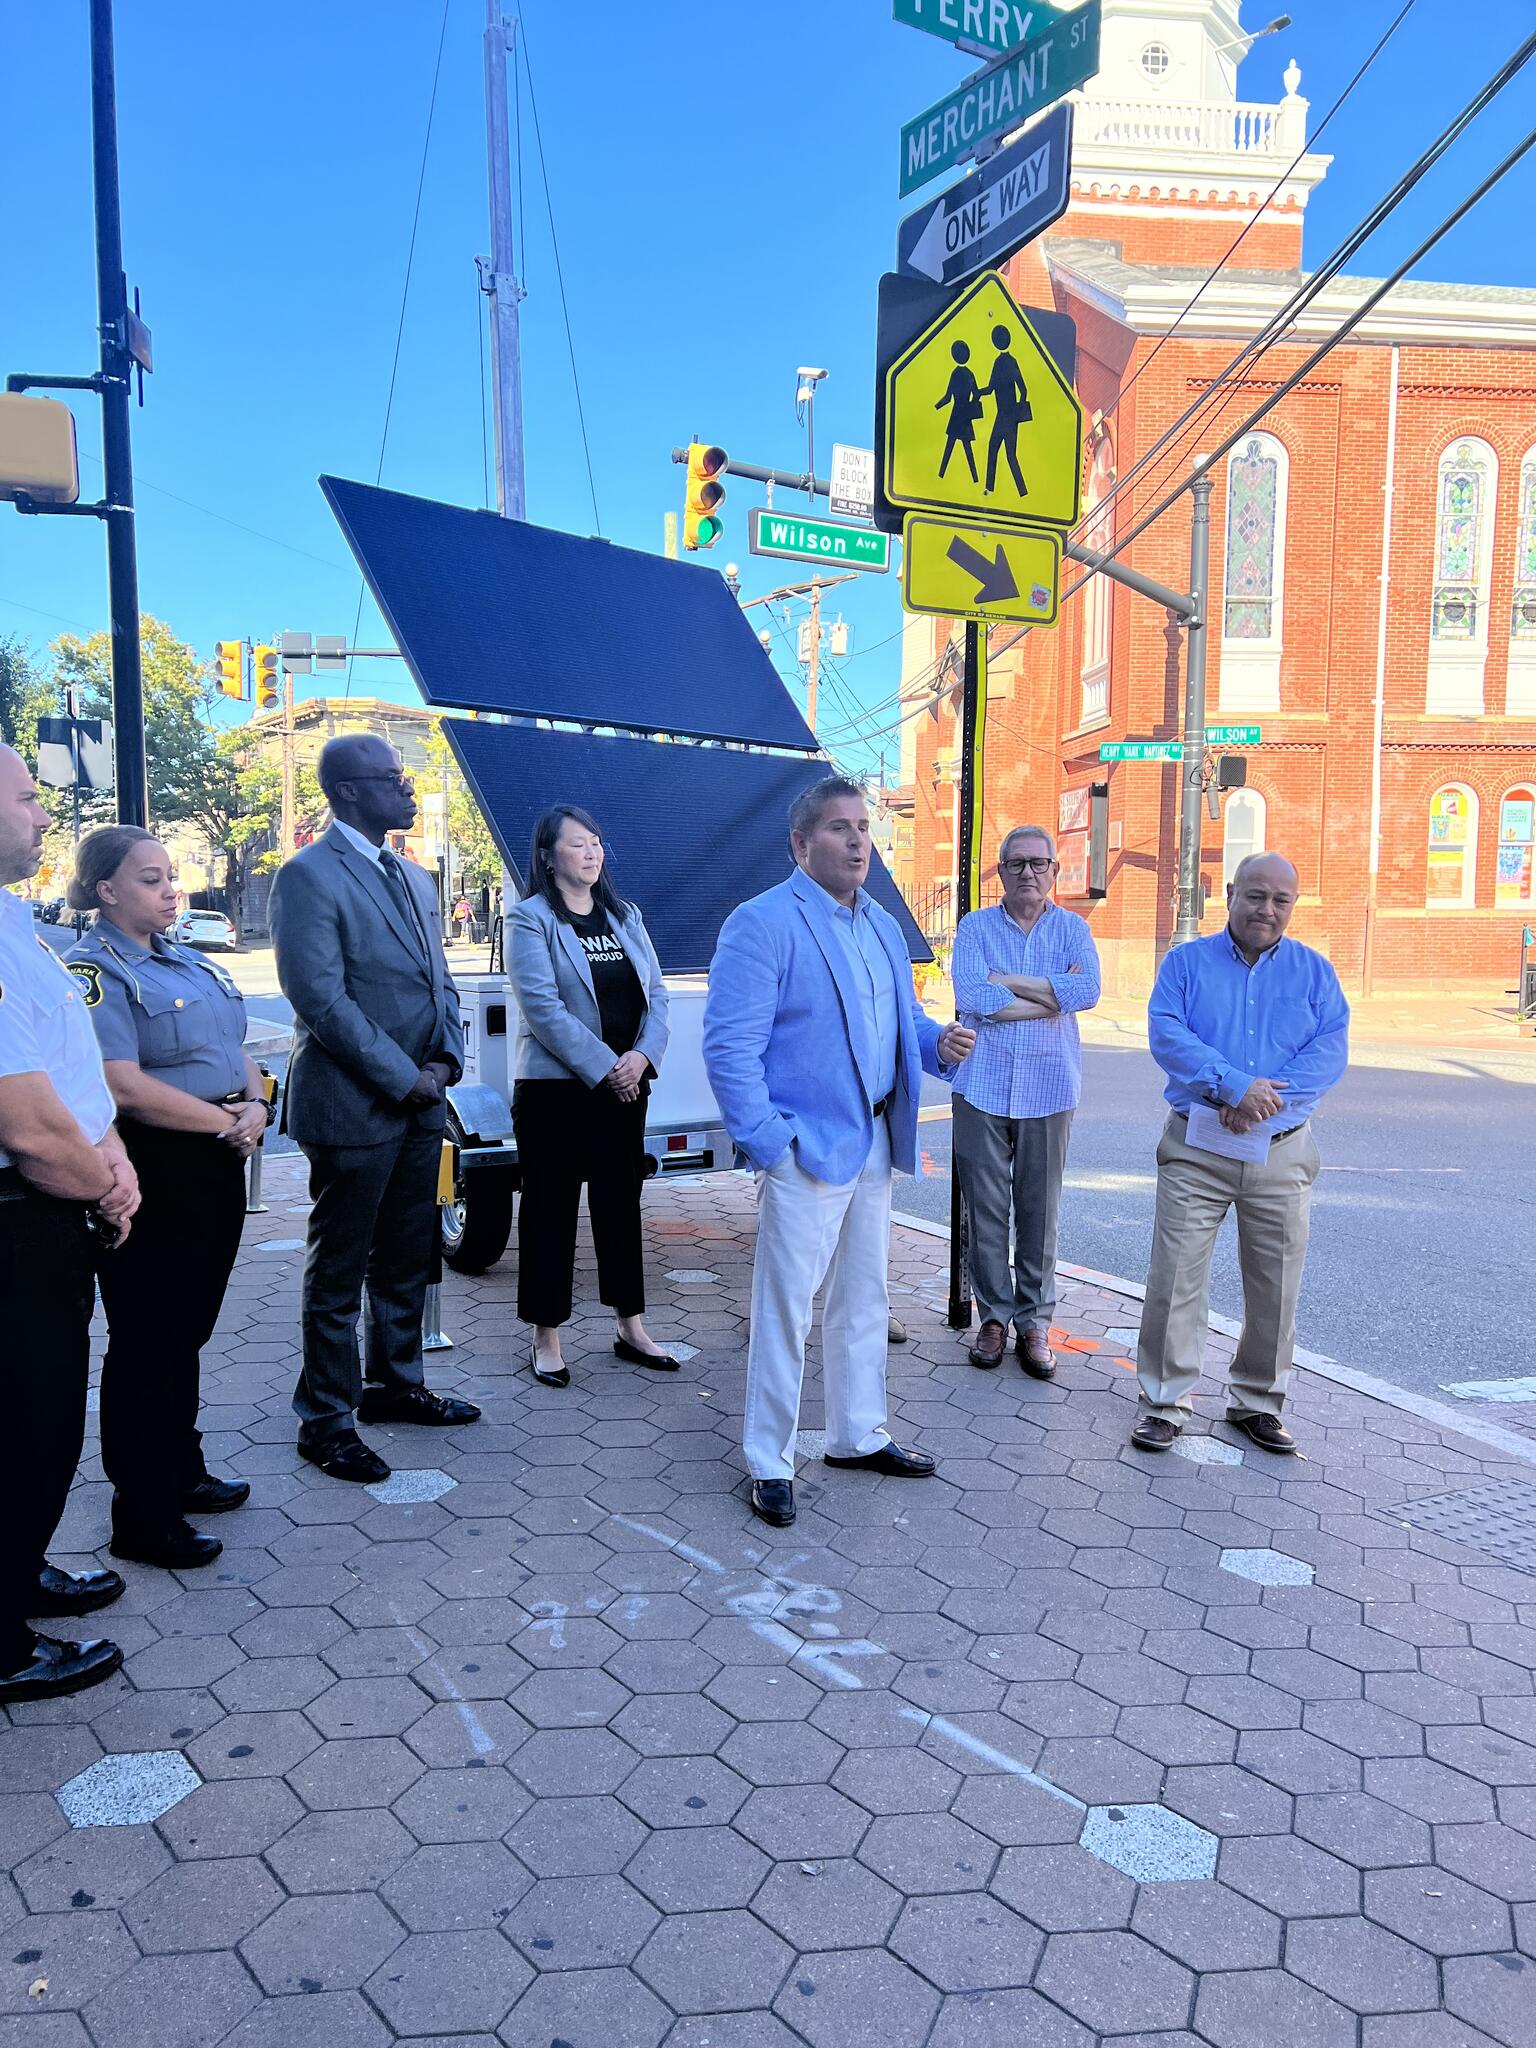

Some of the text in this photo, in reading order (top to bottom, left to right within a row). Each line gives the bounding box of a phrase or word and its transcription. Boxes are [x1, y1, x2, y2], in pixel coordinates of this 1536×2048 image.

[907, 15, 1089, 176] MERCHANT ST
[945, 150, 1048, 252] ONE WAY
[840, 468, 868, 485] BLOCK
[834, 483, 872, 503] THE BOX
[770, 522, 878, 554] Wilson Ave
[1207, 727, 1259, 741] WILSON AV
[587, 951, 624, 962] PROUD
